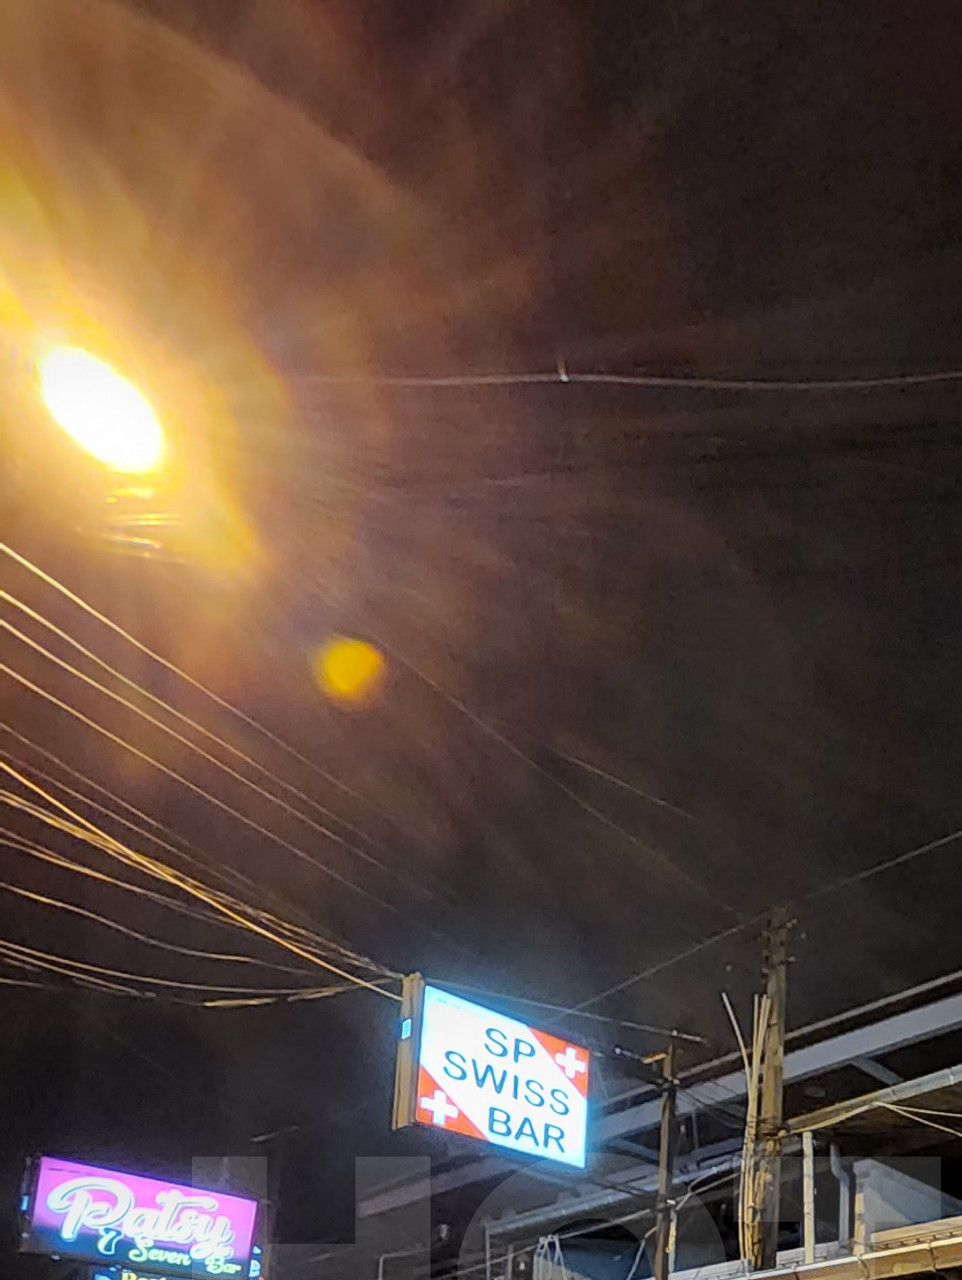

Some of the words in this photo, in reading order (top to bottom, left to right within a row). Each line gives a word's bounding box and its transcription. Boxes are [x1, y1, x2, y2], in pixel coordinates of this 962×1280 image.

[485, 1027, 536, 1063] SP
[443, 1050, 570, 1116] SWISS
[488, 1106, 565, 1153] BAR
[128, 1236, 191, 1267] Seven
[204, 1254, 242, 1274] Bar
